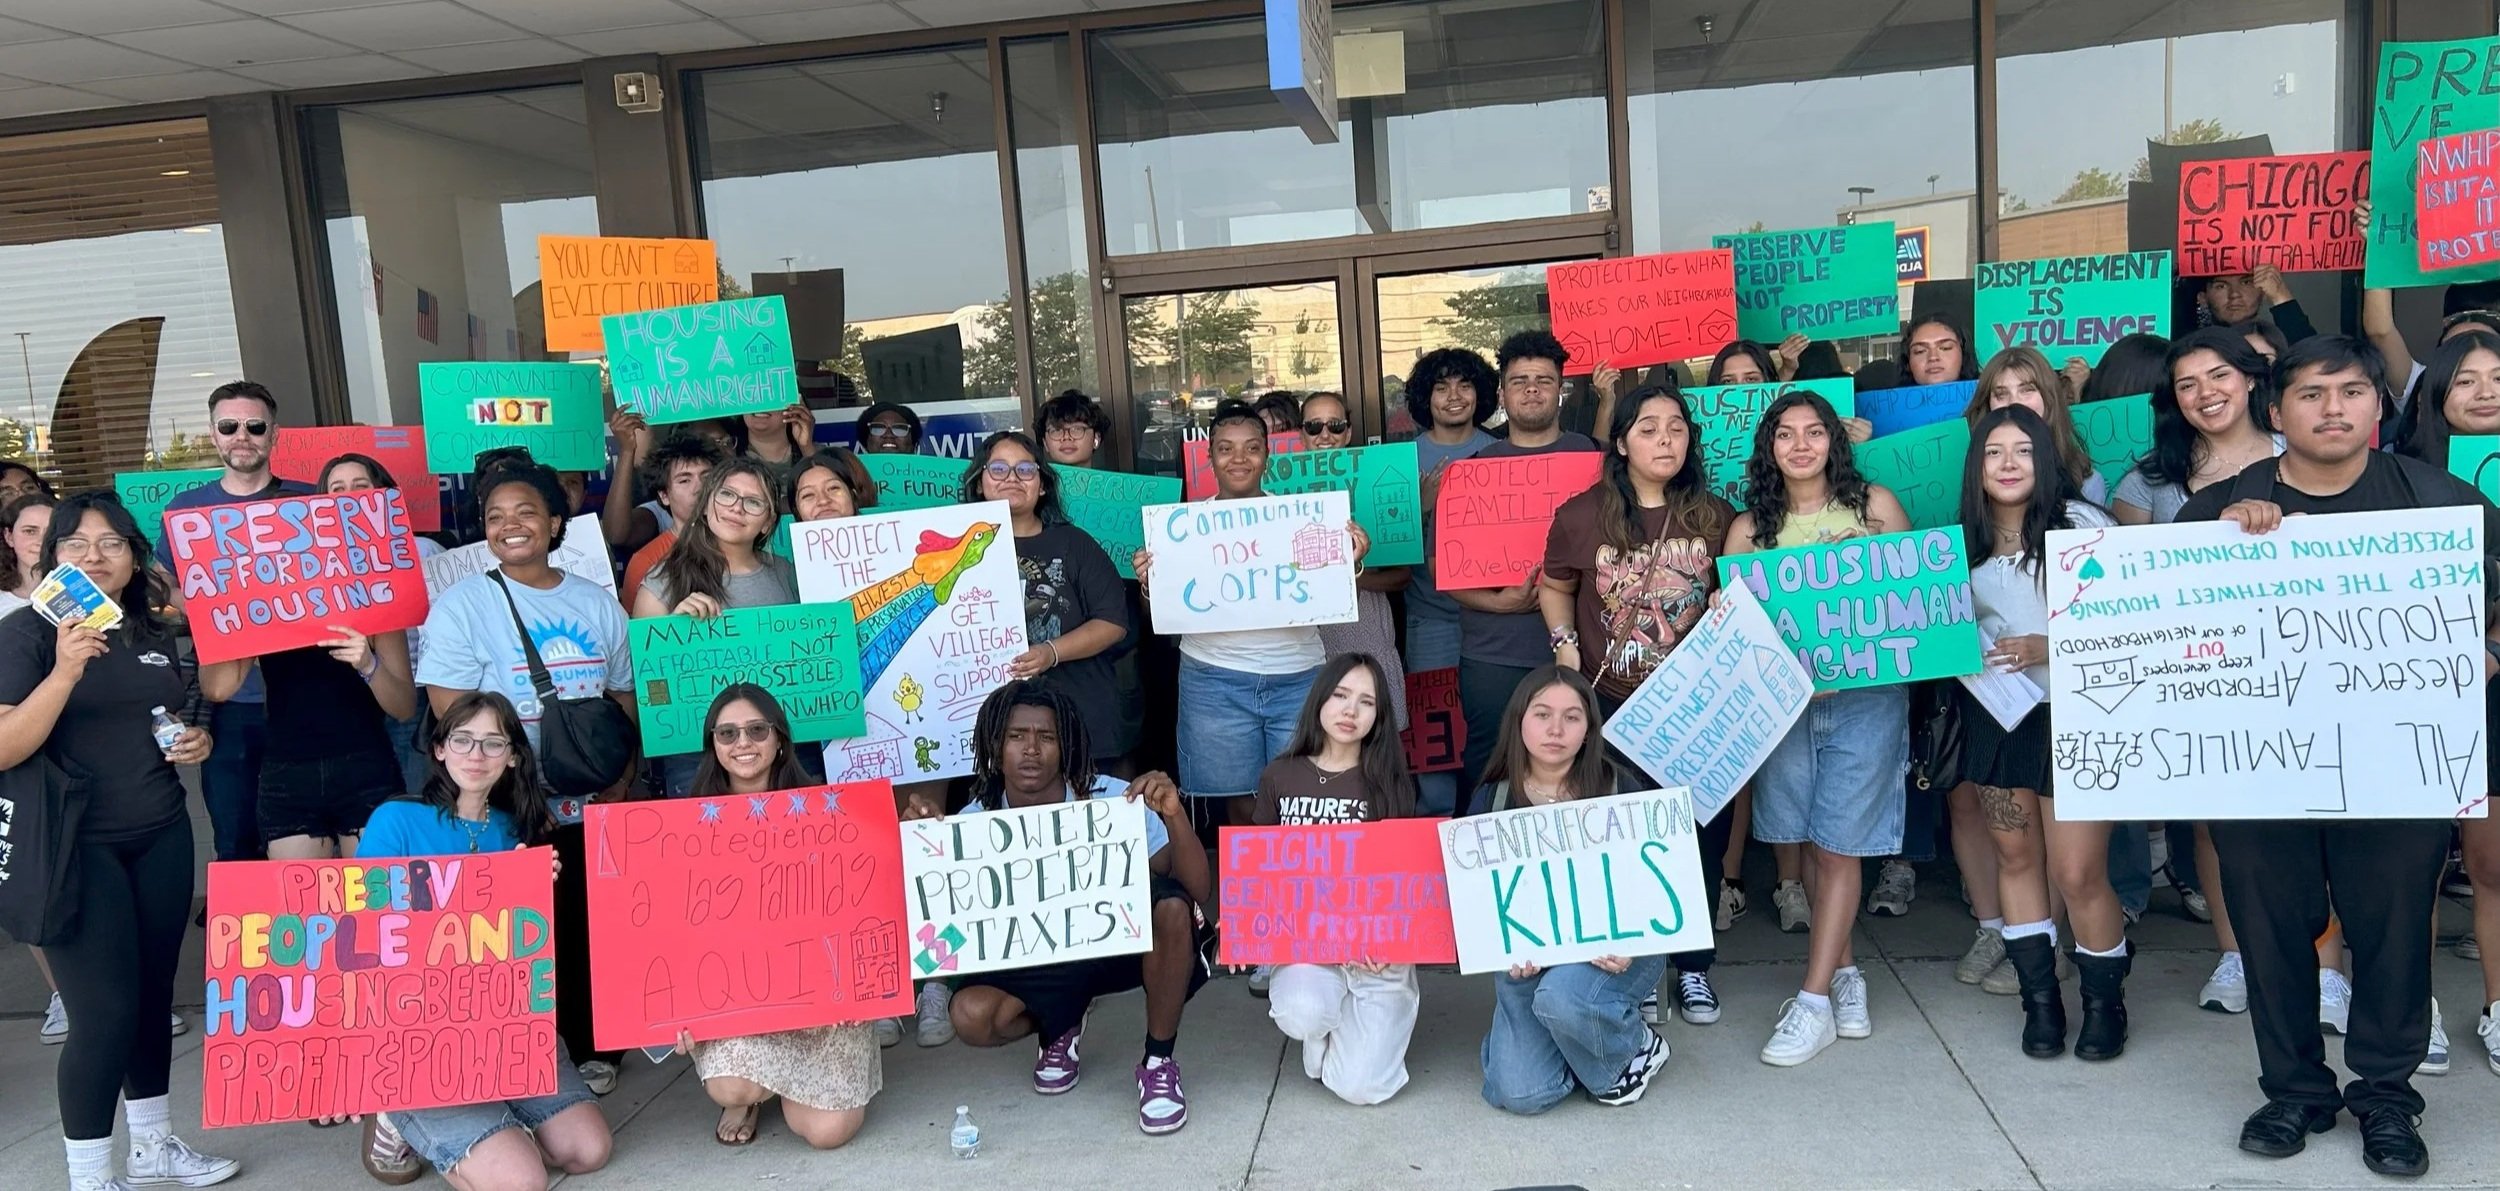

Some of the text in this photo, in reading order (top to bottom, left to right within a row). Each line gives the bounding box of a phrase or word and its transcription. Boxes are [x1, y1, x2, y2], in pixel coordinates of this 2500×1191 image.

[2385, 45, 2500, 100] PRE
[2183, 159, 2372, 215] CHICAGO
[1717, 229, 1846, 261] PRESERVE
[2183, 218, 2224, 245] IS
[2241, 213, 2296, 241] NOT
[2428, 230, 2500, 263] PROTE
[550, 243, 664, 279] YOU CAN'T
[1555, 253, 1730, 291] PROTECTING WHAT
[1734, 257, 1831, 286] PEOPLE
[1977, 253, 2167, 290] DISPLACEMENT
[2183, 246, 2236, 273] THE
[549, 282, 632, 319] EVICT
[1554, 298, 1607, 324] MAKES
[1617, 293, 1649, 311] OUR
[1735, 285, 1784, 310] NOT
[1780, 295, 1898, 331] PROPERTY
[2028, 287, 2064, 316] IS
[618, 300, 775, 350] HOUSING
[1992, 315, 2156, 349] VIOLENCE
[656, 335, 735, 381] IS A
[430, 365, 600, 397] COMMUNITY
[1901, 381, 1967, 408] ORDINA
[478, 399, 549, 423] NOT
[1682, 383, 1796, 417] OUSING
[430, 429, 600, 464] COMMODITY
[1894, 434, 1951, 479] NOT
[1263, 449, 1363, 484] ROTECT
[1448, 457, 1555, 491] PROTECT
[126, 482, 170, 505] STOP
[903, 480, 966, 499] FUTURE
[1060, 470, 1158, 504] ESERVE
[1899, 481, 1944, 508] TO
[168, 487, 410, 560] PRESERVE
[1166, 498, 1324, 543] Community
[1446, 490, 1580, 527] FAMILI
[805, 520, 902, 562] PROTECT
[2290, 527, 2474, 559] PRESERVATION
[183, 537, 414, 600] AFFORDABLE
[834, 558, 877, 588] THE
[1729, 530, 1957, 601] HOUSING
[211, 581, 394, 634] HOUSING
[2069, 561, 2481, 621] KEEP THE NORTHWEST HOUSING
[951, 600, 1000, 627] GET
[1776, 581, 1975, 642] A HUMAN
[645, 614, 741, 651] MAKE
[791, 634, 841, 660] NOT
[929, 626, 1023, 658] VILLEGAS
[2183, 641, 2225, 659] OUT
[1797, 636, 1918, 681] IGHT
[2143, 659, 2211, 677] developers
[934, 663, 1015, 703] SUPPOR
[1612, 661, 1687, 746] PROTECT
[1686, 620, 1719, 660] THE
[1640, 628, 1750, 768] NORTHWEST SIDE
[2156, 654, 2473, 707] deserve AFFORDABLE
[1664, 679, 1756, 786] PRESERVATION
[2151, 723, 2479, 812] ALL FAMILIES
[1279, 796, 1368, 818] NATURE'S
[945, 800, 1113, 861] LOWER
[1448, 791, 1693, 870] GENTRIFICATION
[1229, 831, 1364, 872] FIGHT
[282, 856, 492, 914] PRESERVE
[915, 838, 1140, 920] PROPERTY
[1491, 841, 1684, 954] KILLS
[631, 881, 651, 927] a
[209, 906, 549, 971] PEOPLE AND
[967, 901, 1116, 961] TAXES
[205, 958, 555, 1037] HOUSING BEFORE
